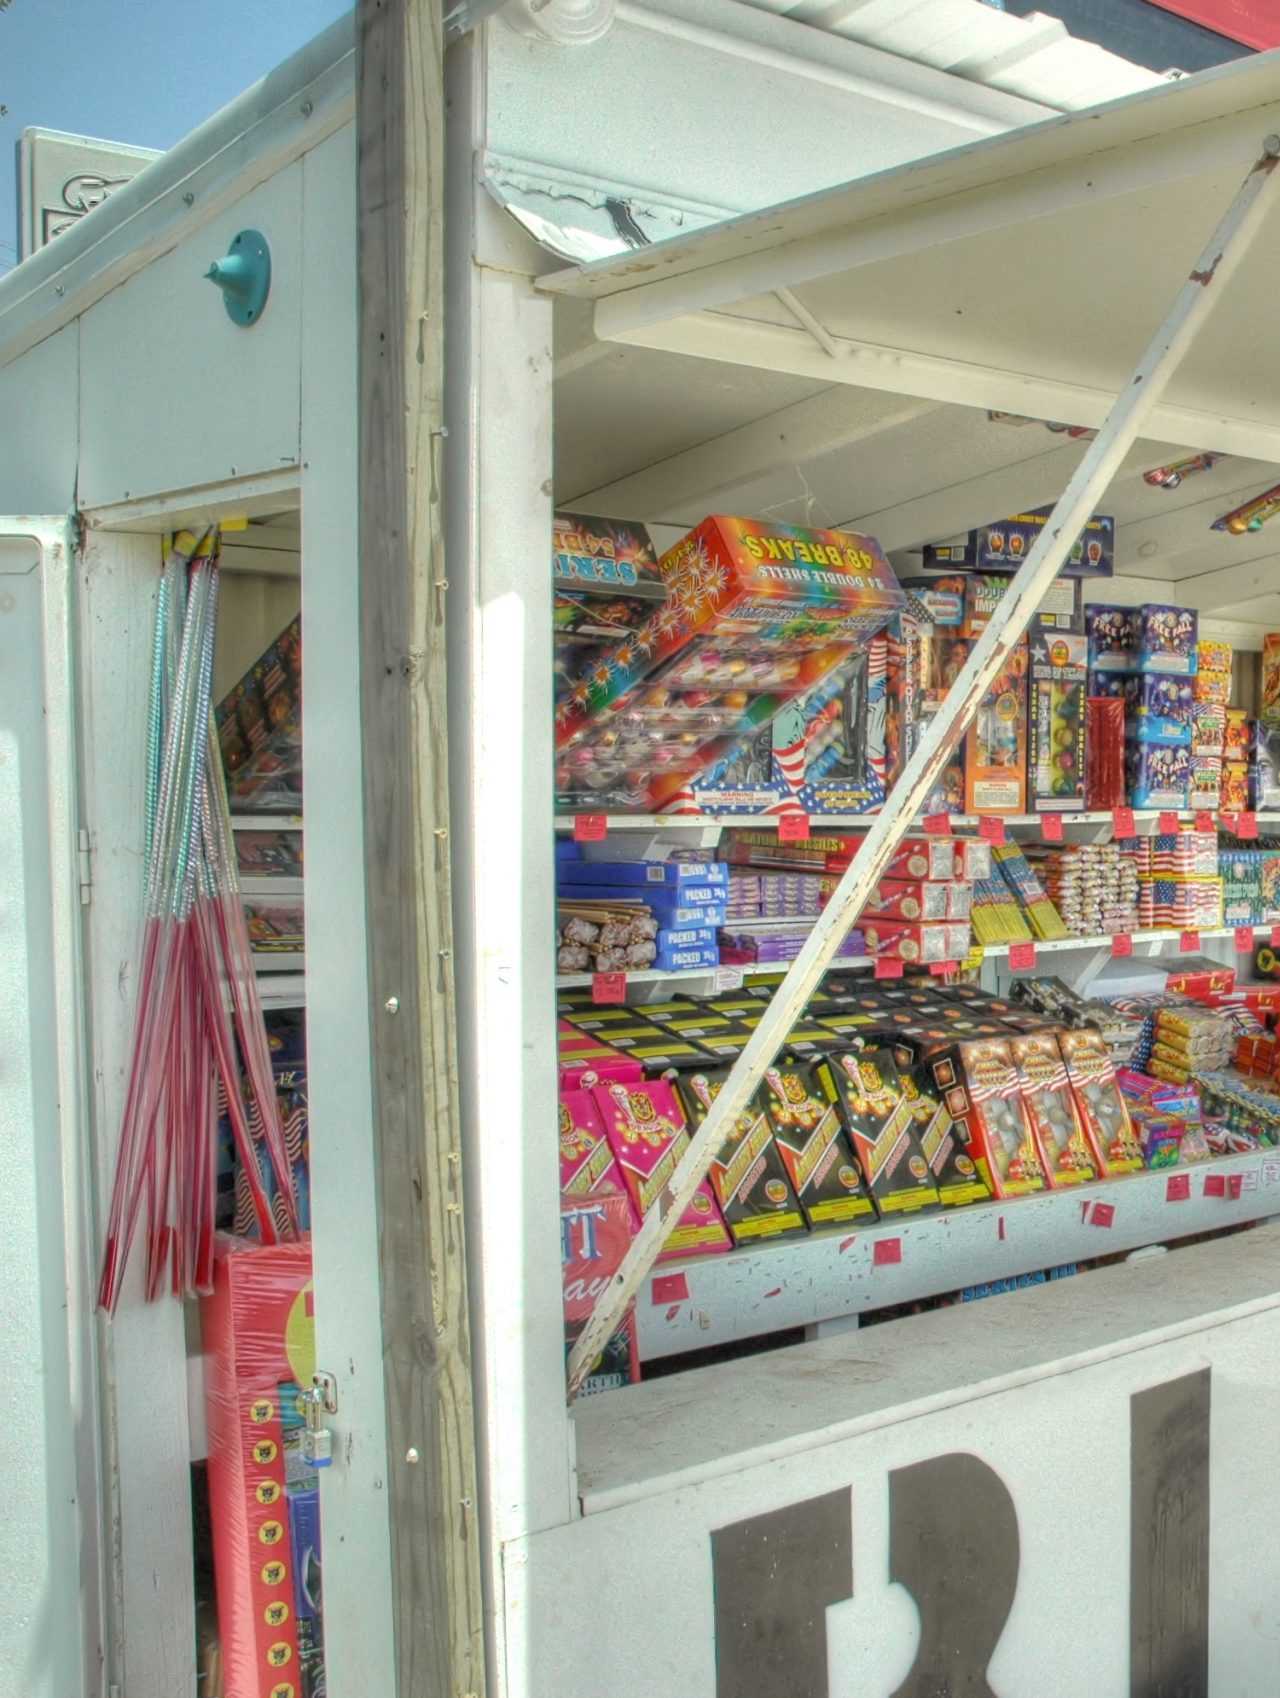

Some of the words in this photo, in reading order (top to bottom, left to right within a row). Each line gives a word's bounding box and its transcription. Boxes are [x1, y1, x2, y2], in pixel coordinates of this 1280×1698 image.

[745, 535, 843, 567] BREAKS
[848, 547, 873, 570] 48
[556, 553, 639, 586] SERI
[759, 565, 809, 582] SHELLS
[811, 569, 865, 587] DOUBLE
